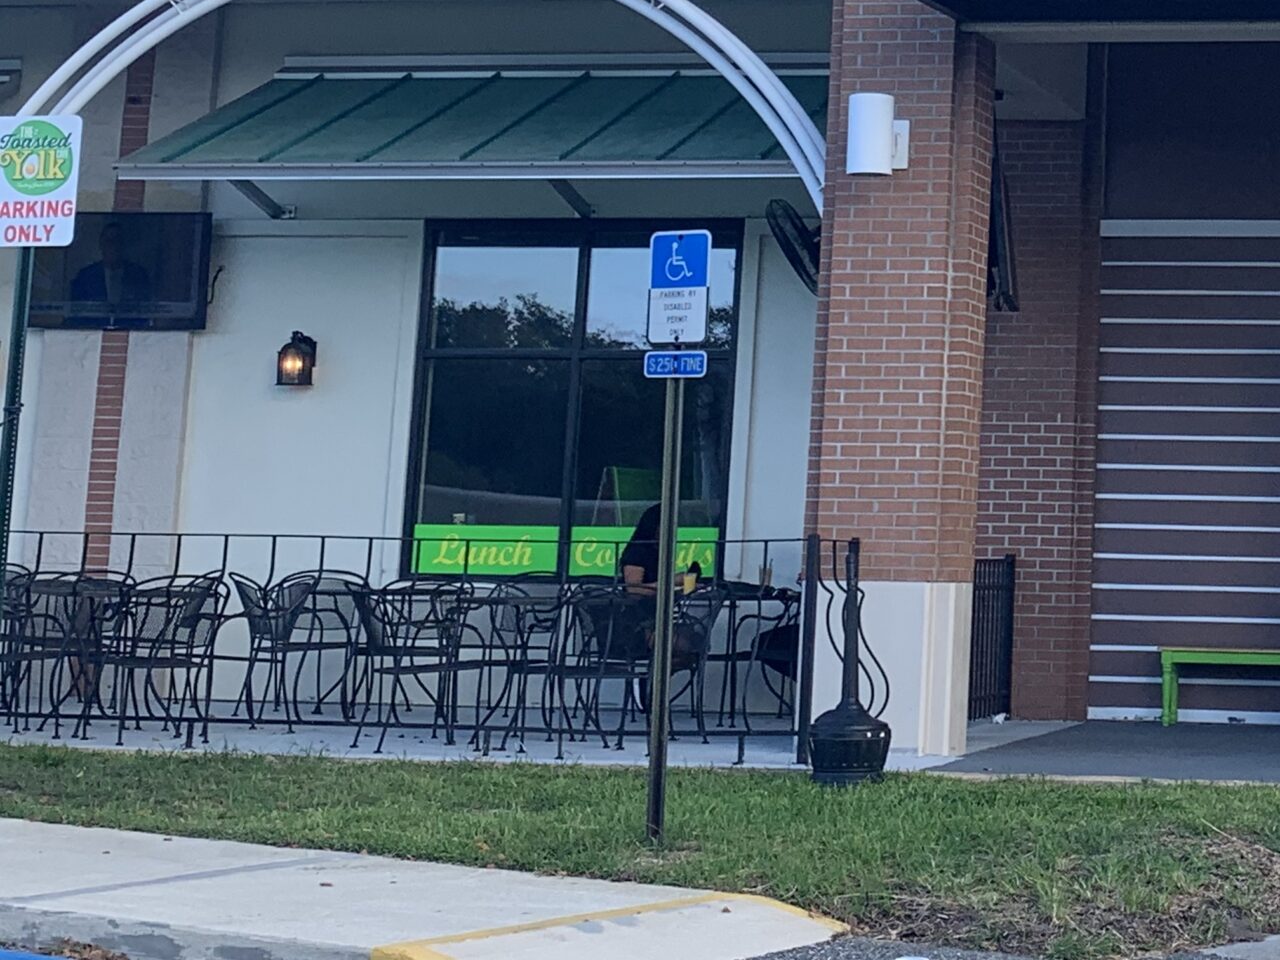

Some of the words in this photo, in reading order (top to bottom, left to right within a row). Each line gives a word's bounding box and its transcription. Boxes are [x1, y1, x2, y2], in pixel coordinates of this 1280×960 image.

[0, 132, 72, 149] Toasted
[0, 149, 65, 180] Yolk
[0, 200, 73, 218] ARKING
[4, 224, 55, 243] ONLY
[680, 357, 704, 372] FINE
[432, 533, 532, 566] Lunch
